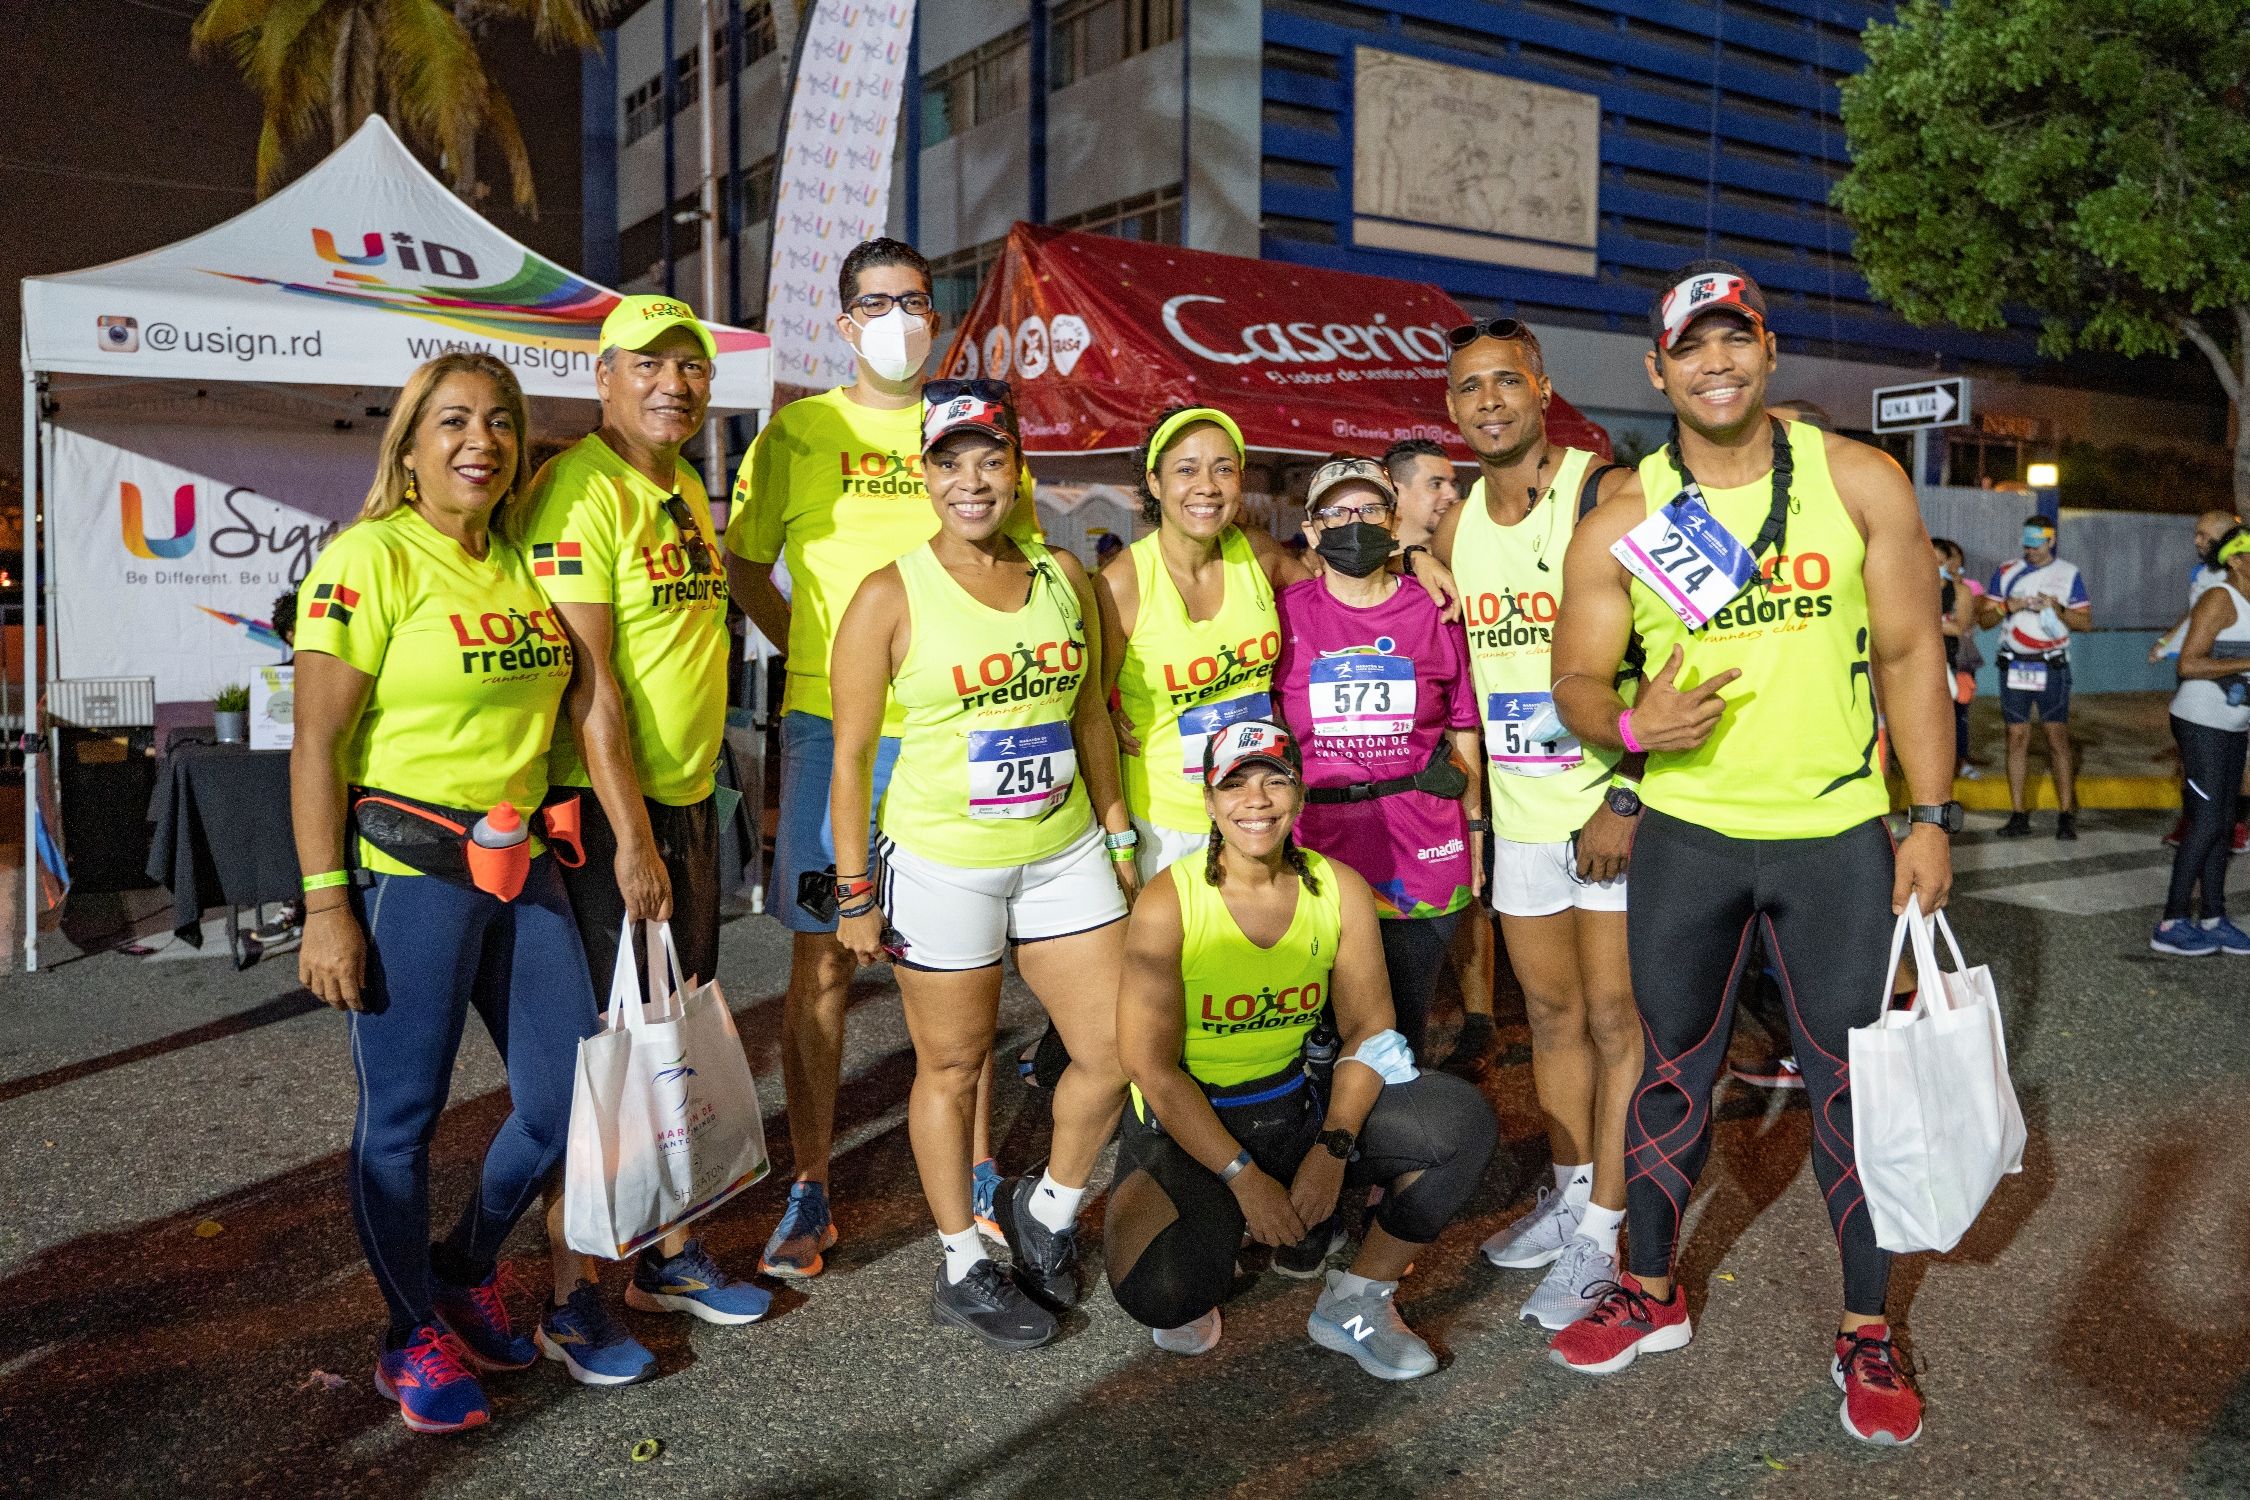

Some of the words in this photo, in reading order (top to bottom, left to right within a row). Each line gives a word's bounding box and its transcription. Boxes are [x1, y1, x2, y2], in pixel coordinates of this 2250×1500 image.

[145, 322, 322, 361] @usign.rd
[1885, 400, 1910, 417] UNA
[1917, 398, 1937, 413] VIA
[841, 452, 924, 477] LOC
[126, 571, 147, 584] Be
[155, 571, 231, 585] Different.
[240, 572, 261, 584] Be
[268, 572, 279, 584] U
[1649, 532, 1714, 595] 274
[1469, 620, 1552, 648] rredore
[462, 639, 573, 674] rredore
[952, 640, 1083, 697] LOCO
[962, 674, 1081, 711] rredores
[1334, 682, 1391, 713] 573
[1313, 735, 1386, 749] MARATÓN
[1391, 735, 1409, 745] DE
[1358, 747, 1410, 759] DOMINGO
[996, 756, 1055, 796] 254
[1417, 838, 1464, 860] amadita
[1201, 982, 1321, 1022] LOCO
